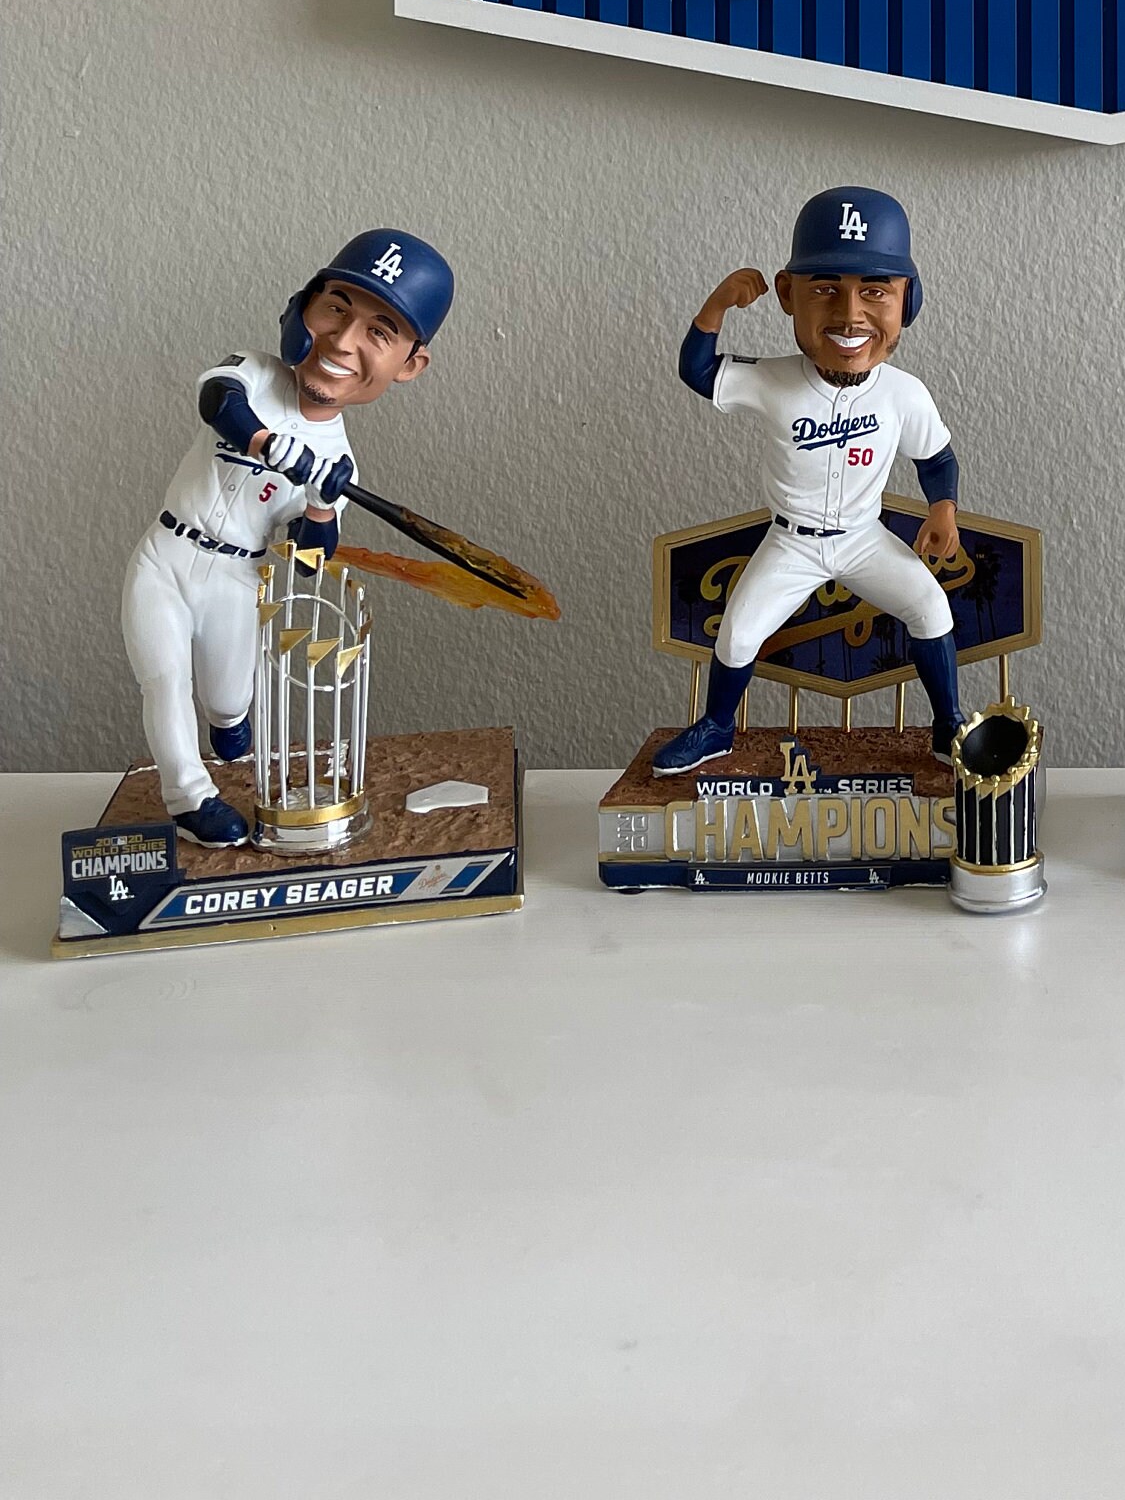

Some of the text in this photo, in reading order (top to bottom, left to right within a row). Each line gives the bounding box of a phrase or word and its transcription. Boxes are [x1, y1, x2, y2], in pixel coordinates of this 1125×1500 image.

[839, 203, 868, 241] LA
[371, 242, 403, 284] LA
[792, 413, 880, 451] Dodgers
[848, 448, 874, 467] 50
[259, 482, 278, 503] 5
[697, 781, 773, 796] WORLD
[780, 742, 816, 794] LA
[838, 778, 912, 794] SERIES
[664, 797, 956, 861] CHAMPIONS
[72, 841, 166, 859] WORLD SERIES
[72, 851, 167, 878] CHAMPIONS
[109, 875, 129, 900] LA
[747, 872, 789, 884] MOOKIE
[796, 871, 829, 884] BETTS
[185, 875, 393, 914] COREY SEAGER
